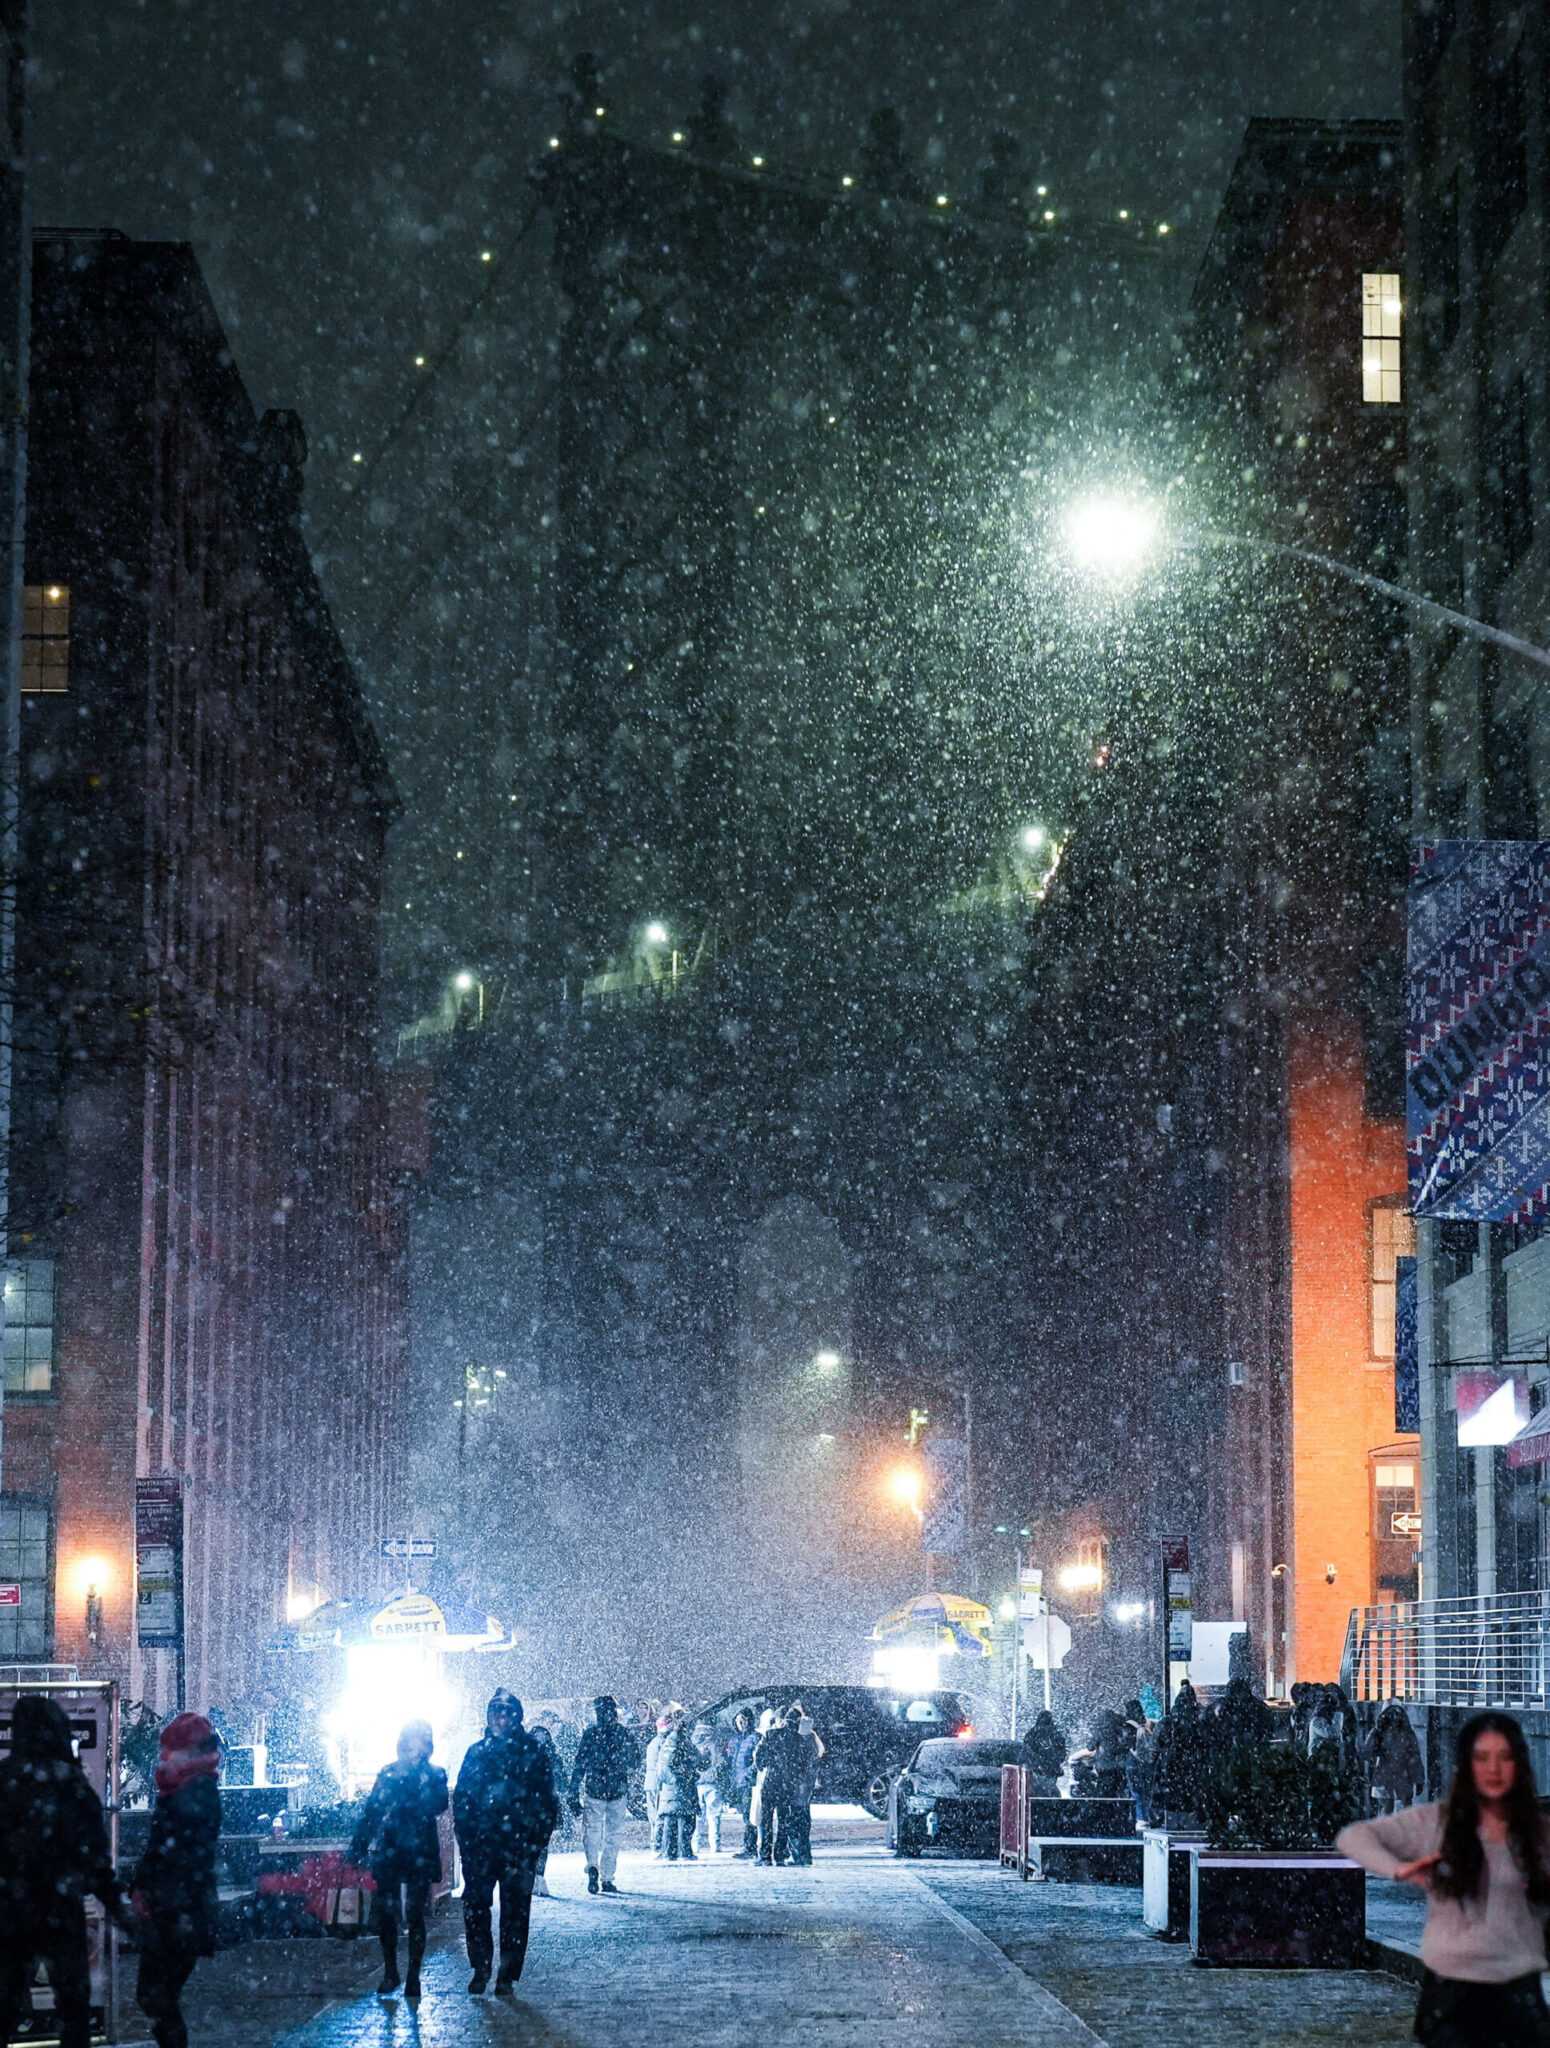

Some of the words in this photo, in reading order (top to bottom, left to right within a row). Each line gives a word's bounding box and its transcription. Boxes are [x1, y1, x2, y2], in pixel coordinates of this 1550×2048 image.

[1409, 957, 1550, 1110] DUMBO
[1400, 1519, 1417, 1527] ONE
[947, 1610, 986, 1619] SABRETT
[375, 1621, 441, 1636] SABRETT
